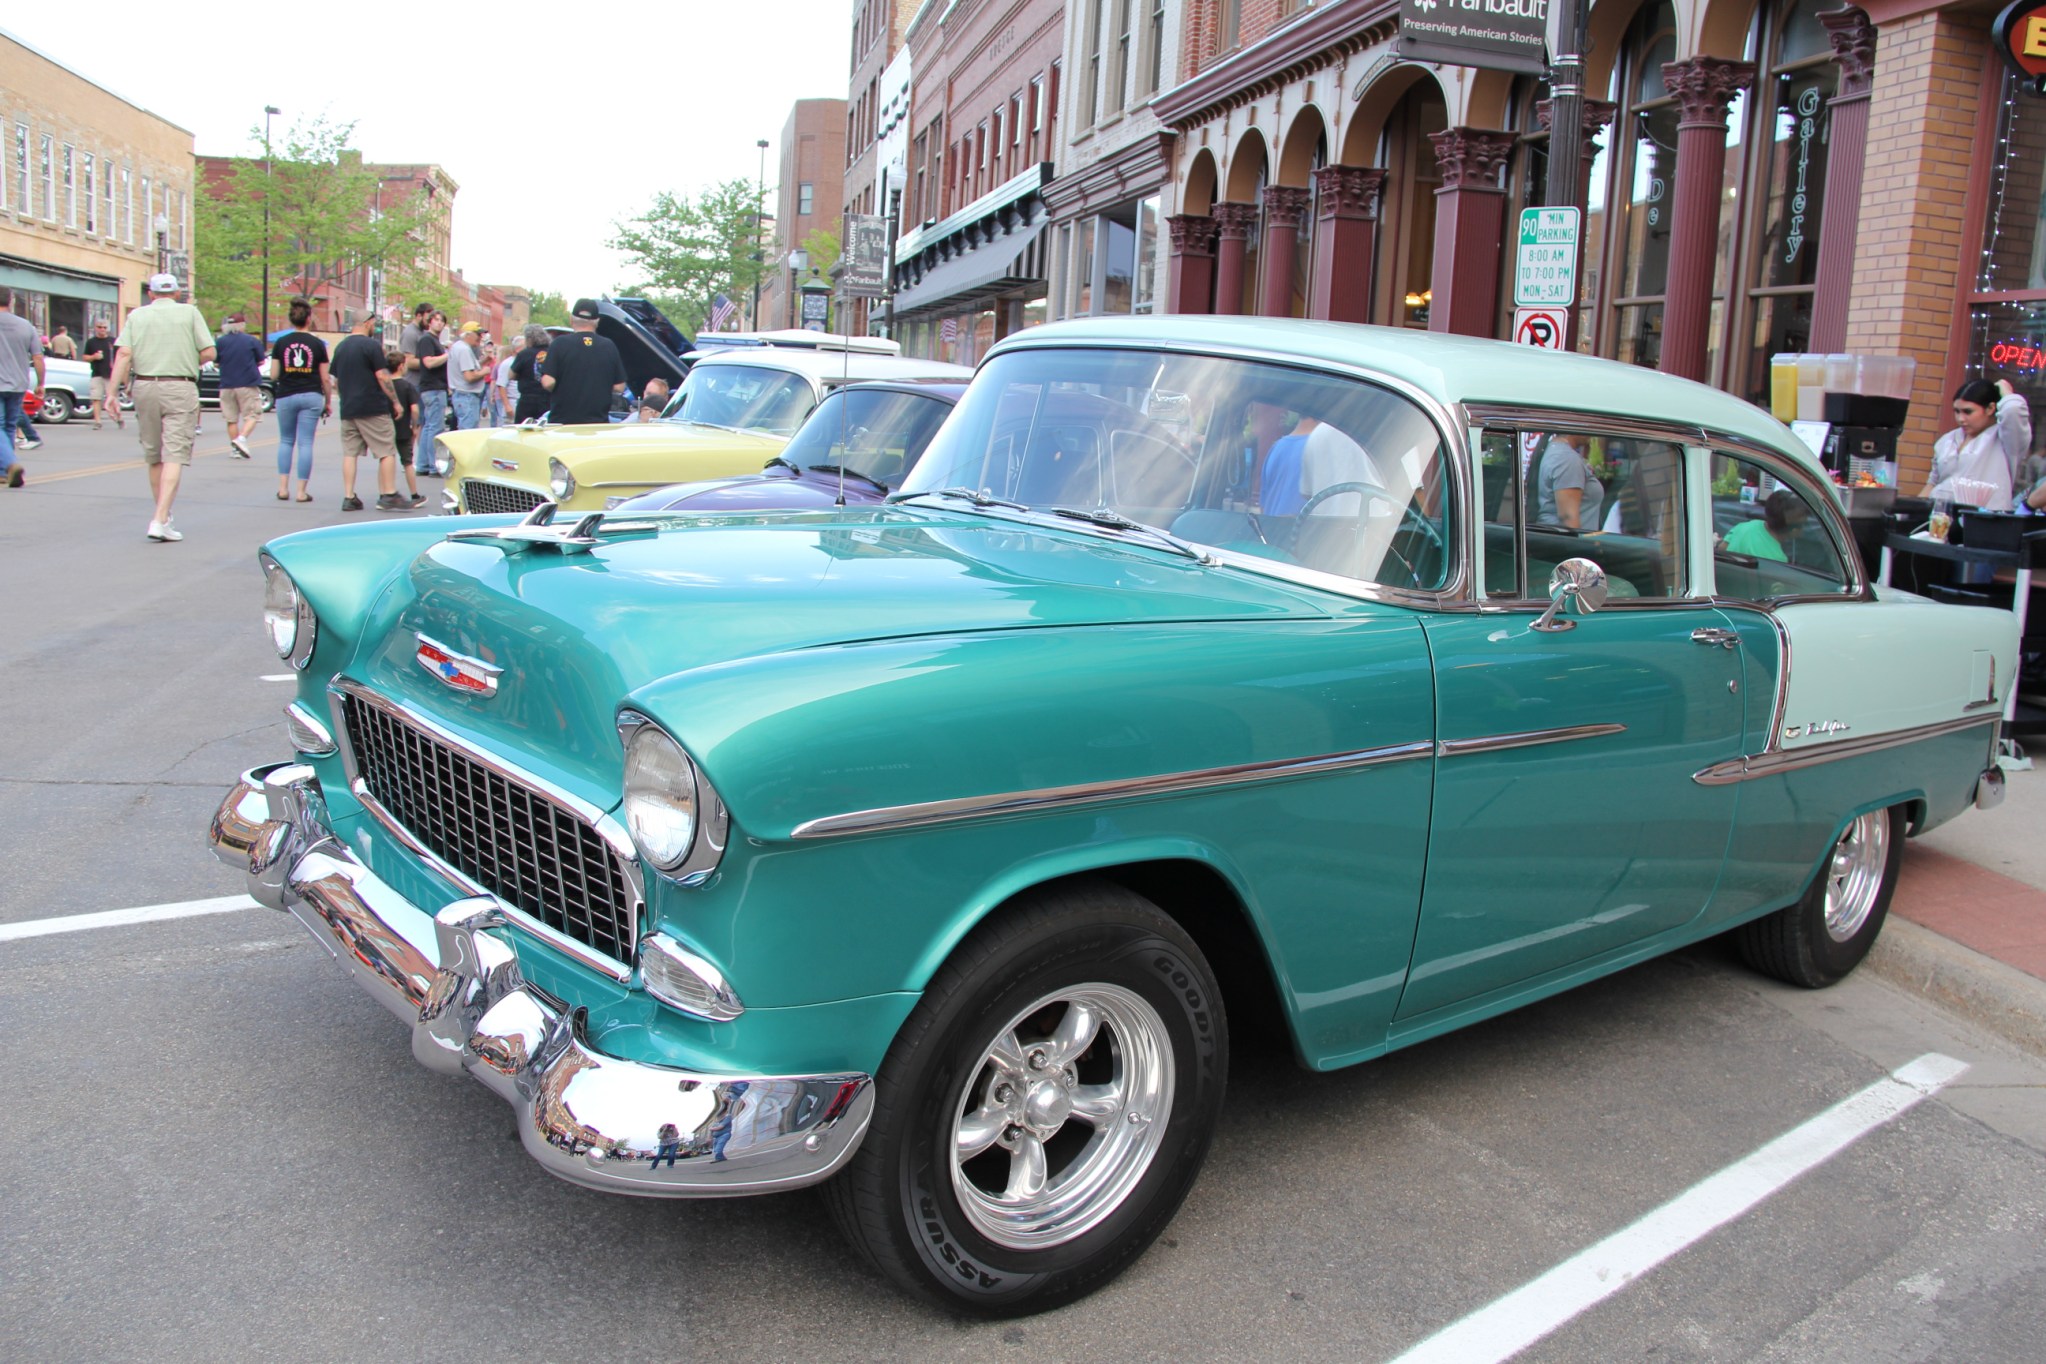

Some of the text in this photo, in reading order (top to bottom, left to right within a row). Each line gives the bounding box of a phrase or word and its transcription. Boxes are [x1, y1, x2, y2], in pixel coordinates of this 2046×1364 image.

[1404, 18, 1542, 45] Preserving American Stories
[1785, 86, 1819, 263] Gallery
[1522, 213, 1564, 236] 90 MIN
[1538, 228, 1573, 240] PARKING
[846, 220, 857, 265] Welcome
[1529, 249, 1564, 261] 8:00 AM
[1522, 267, 1570, 279] TO 7:00 PM
[1991, 344, 2046, 368] OPEN
